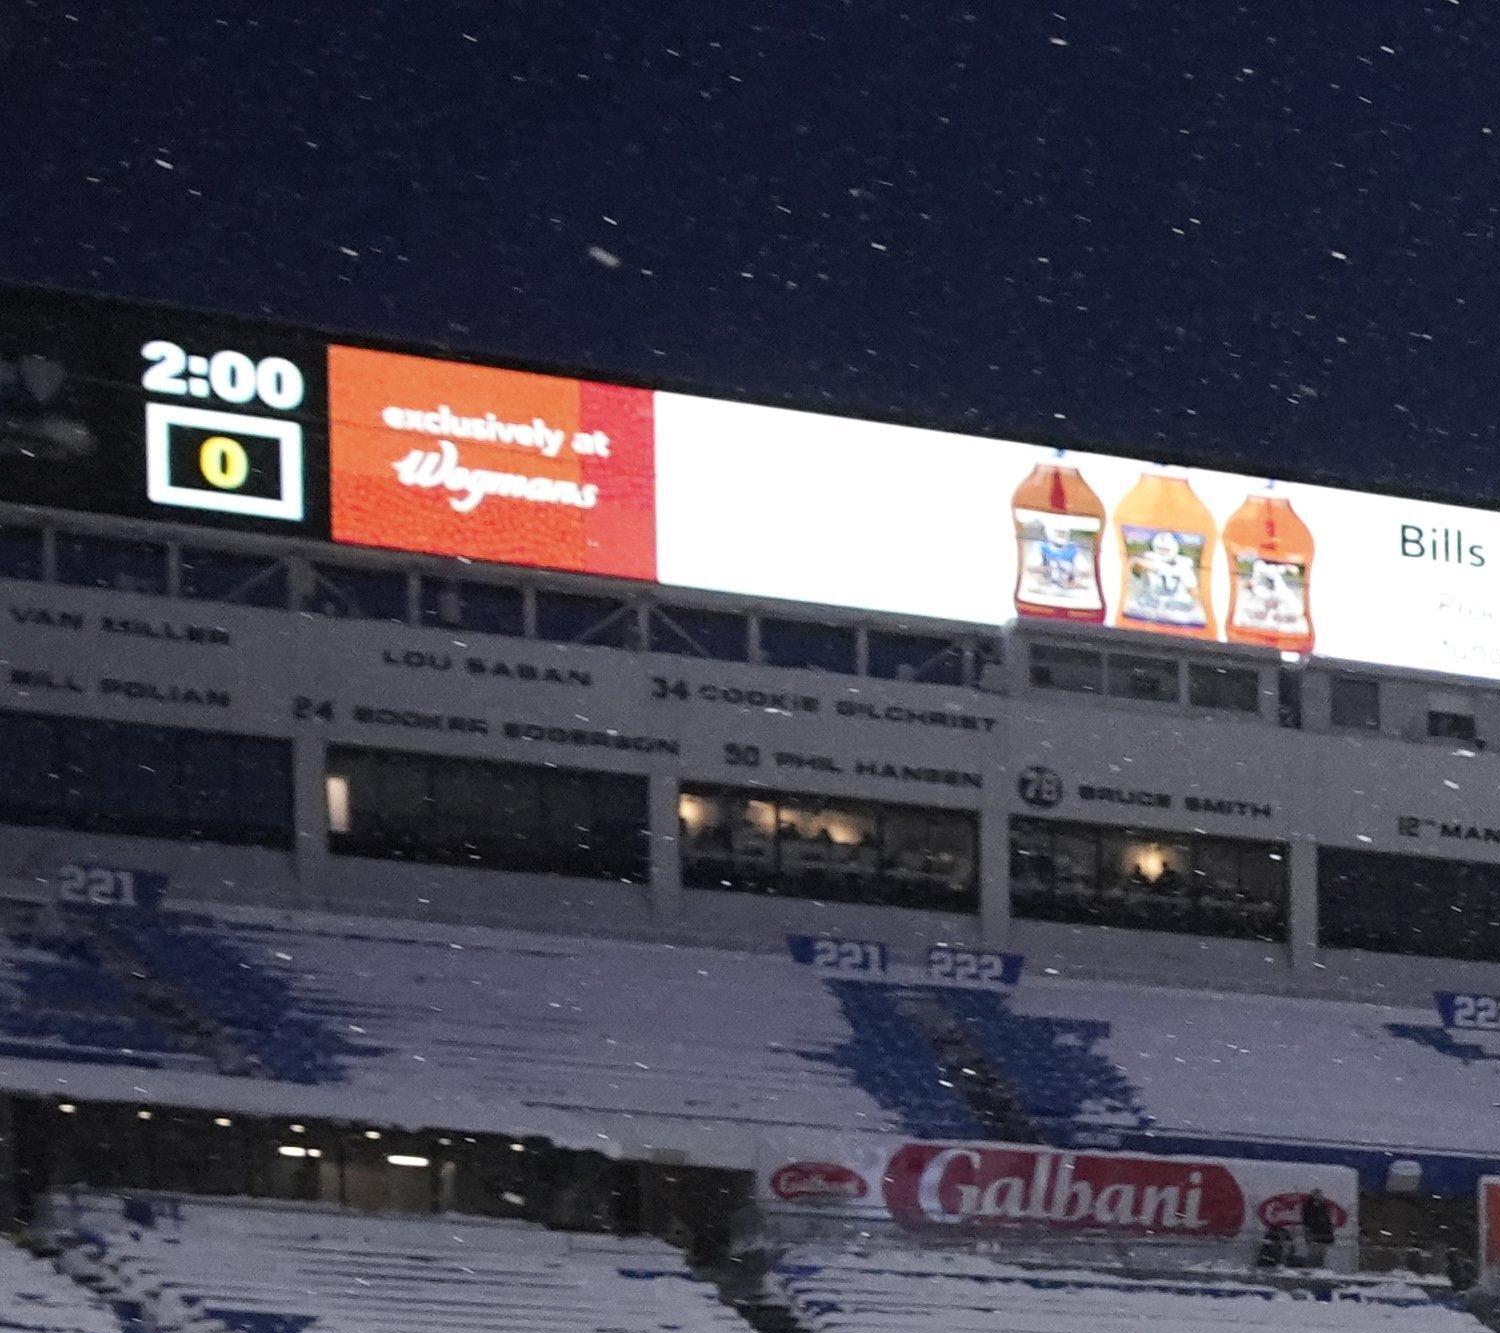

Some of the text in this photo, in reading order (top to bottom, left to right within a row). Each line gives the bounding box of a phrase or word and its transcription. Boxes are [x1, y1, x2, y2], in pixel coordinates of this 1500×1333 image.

[141, 341, 303, 410] 2:00
[382, 405, 610, 459] exclusively at
[200, 436, 248, 489] 0
[392, 441, 598, 511] Wegmans
[1401, 523, 1485, 569] Bills
[382, 648, 452, 671] LOU
[59, 865, 136, 907] 221
[813, 940, 881, 977] 221
[928, 948, 1003, 985] 222
[918, 1150, 1209, 1229] Galbani
